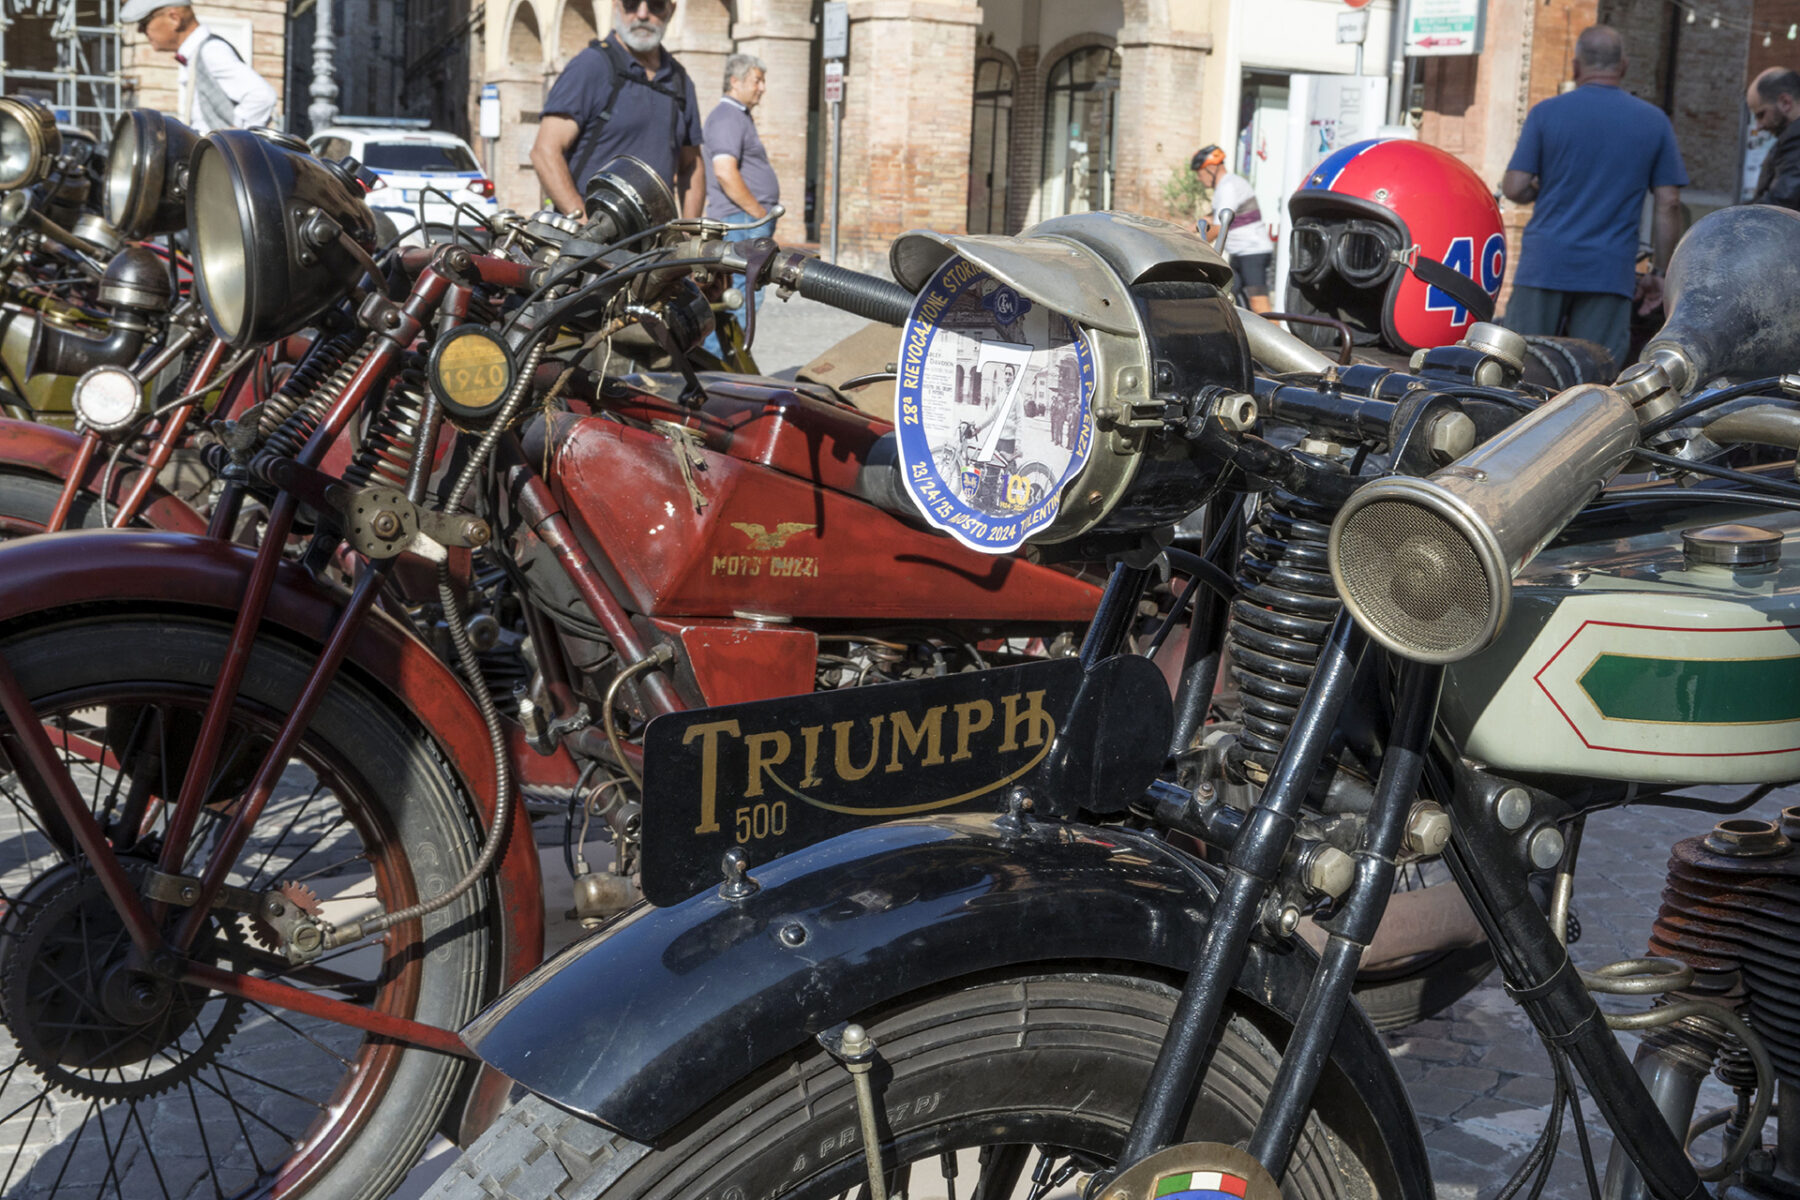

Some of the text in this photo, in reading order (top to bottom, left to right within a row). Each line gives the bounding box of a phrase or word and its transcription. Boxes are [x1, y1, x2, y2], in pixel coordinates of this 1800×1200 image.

[1425, 232, 1507, 327] 40
[903, 290, 949, 389] RIEVOCAZIONE
[443, 365, 504, 391] 1940
[912, 461, 954, 518] 23/24/25
[986, 523, 1017, 542] 2024
[769, 556, 819, 577] GUZZI
[681, 690, 1056, 835] TRIUMPH
[736, 801, 788, 844] 500
[819, 1126, 856, 1158] PR
